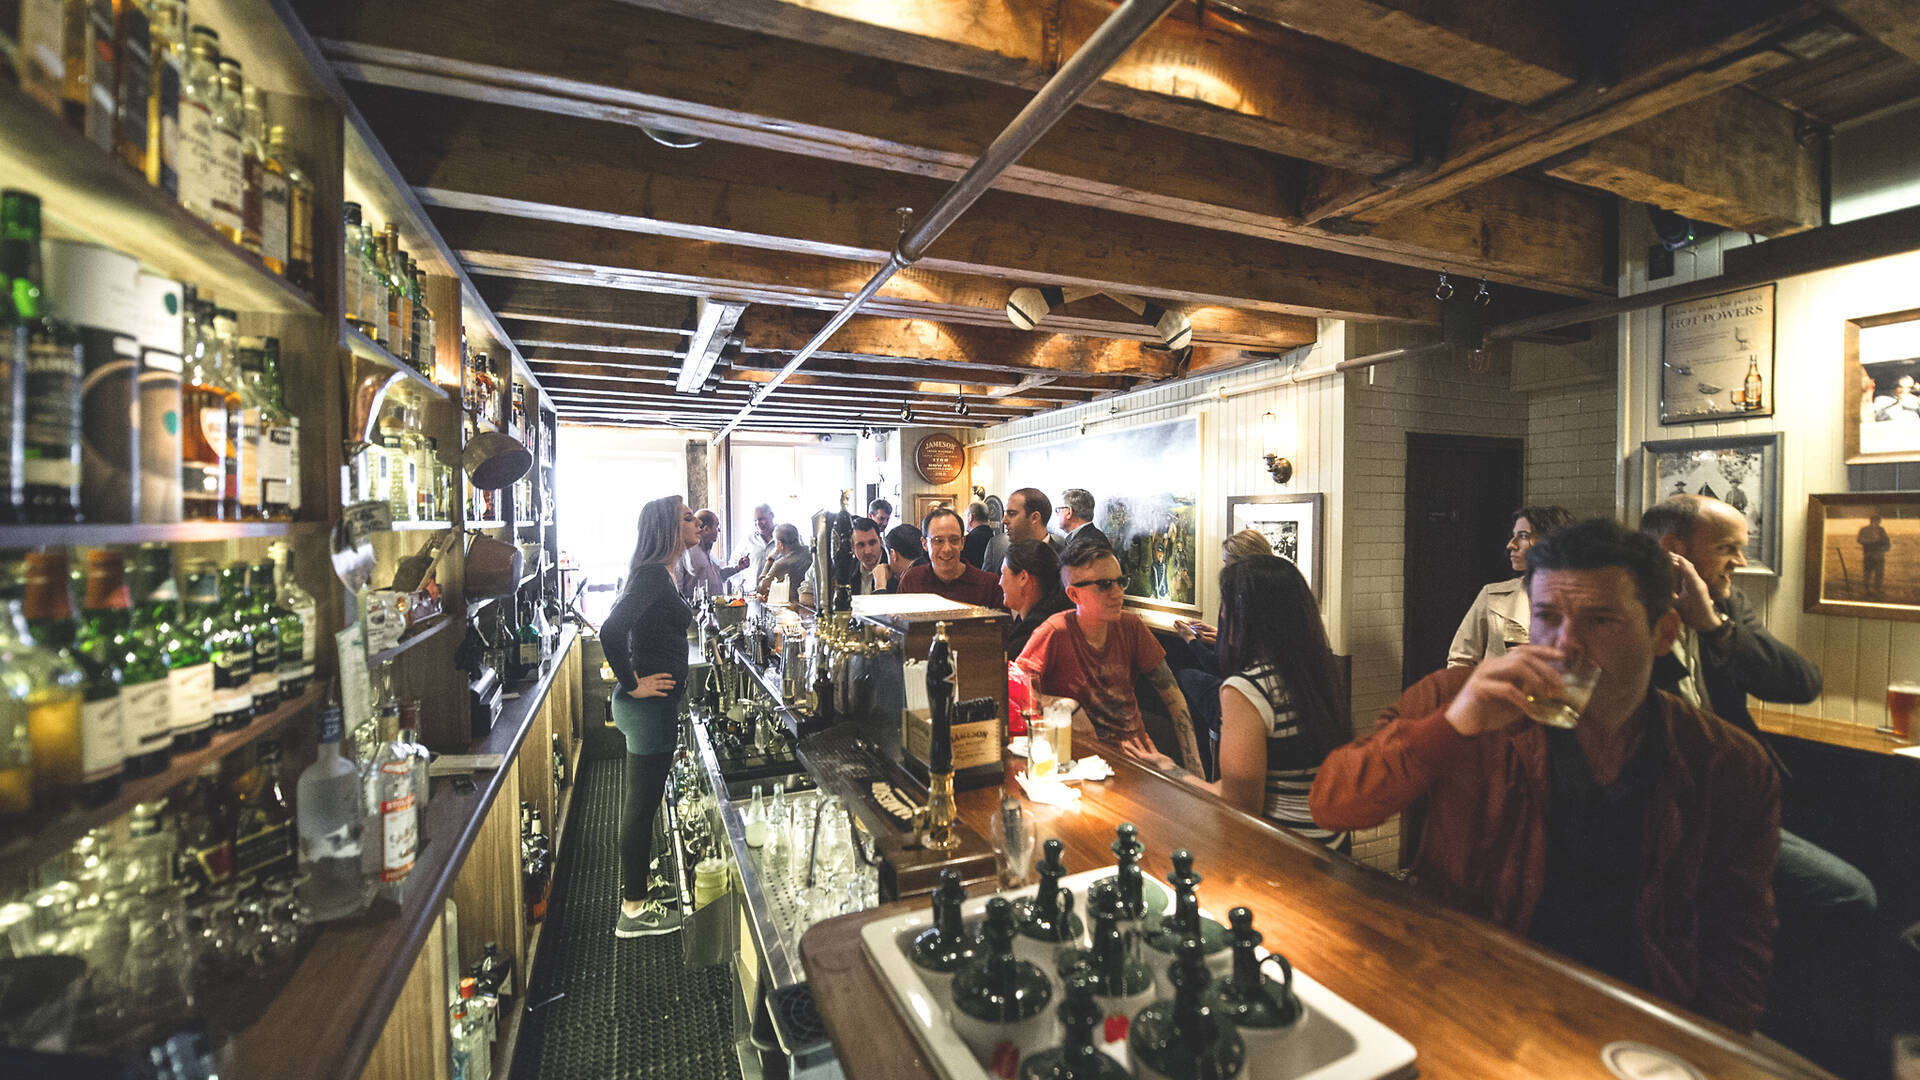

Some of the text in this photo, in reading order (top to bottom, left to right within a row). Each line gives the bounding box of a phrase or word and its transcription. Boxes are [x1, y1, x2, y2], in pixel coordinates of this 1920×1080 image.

[1671, 304, 1765, 329] HOT POWERS
[925, 440, 955, 450] JAMESON
